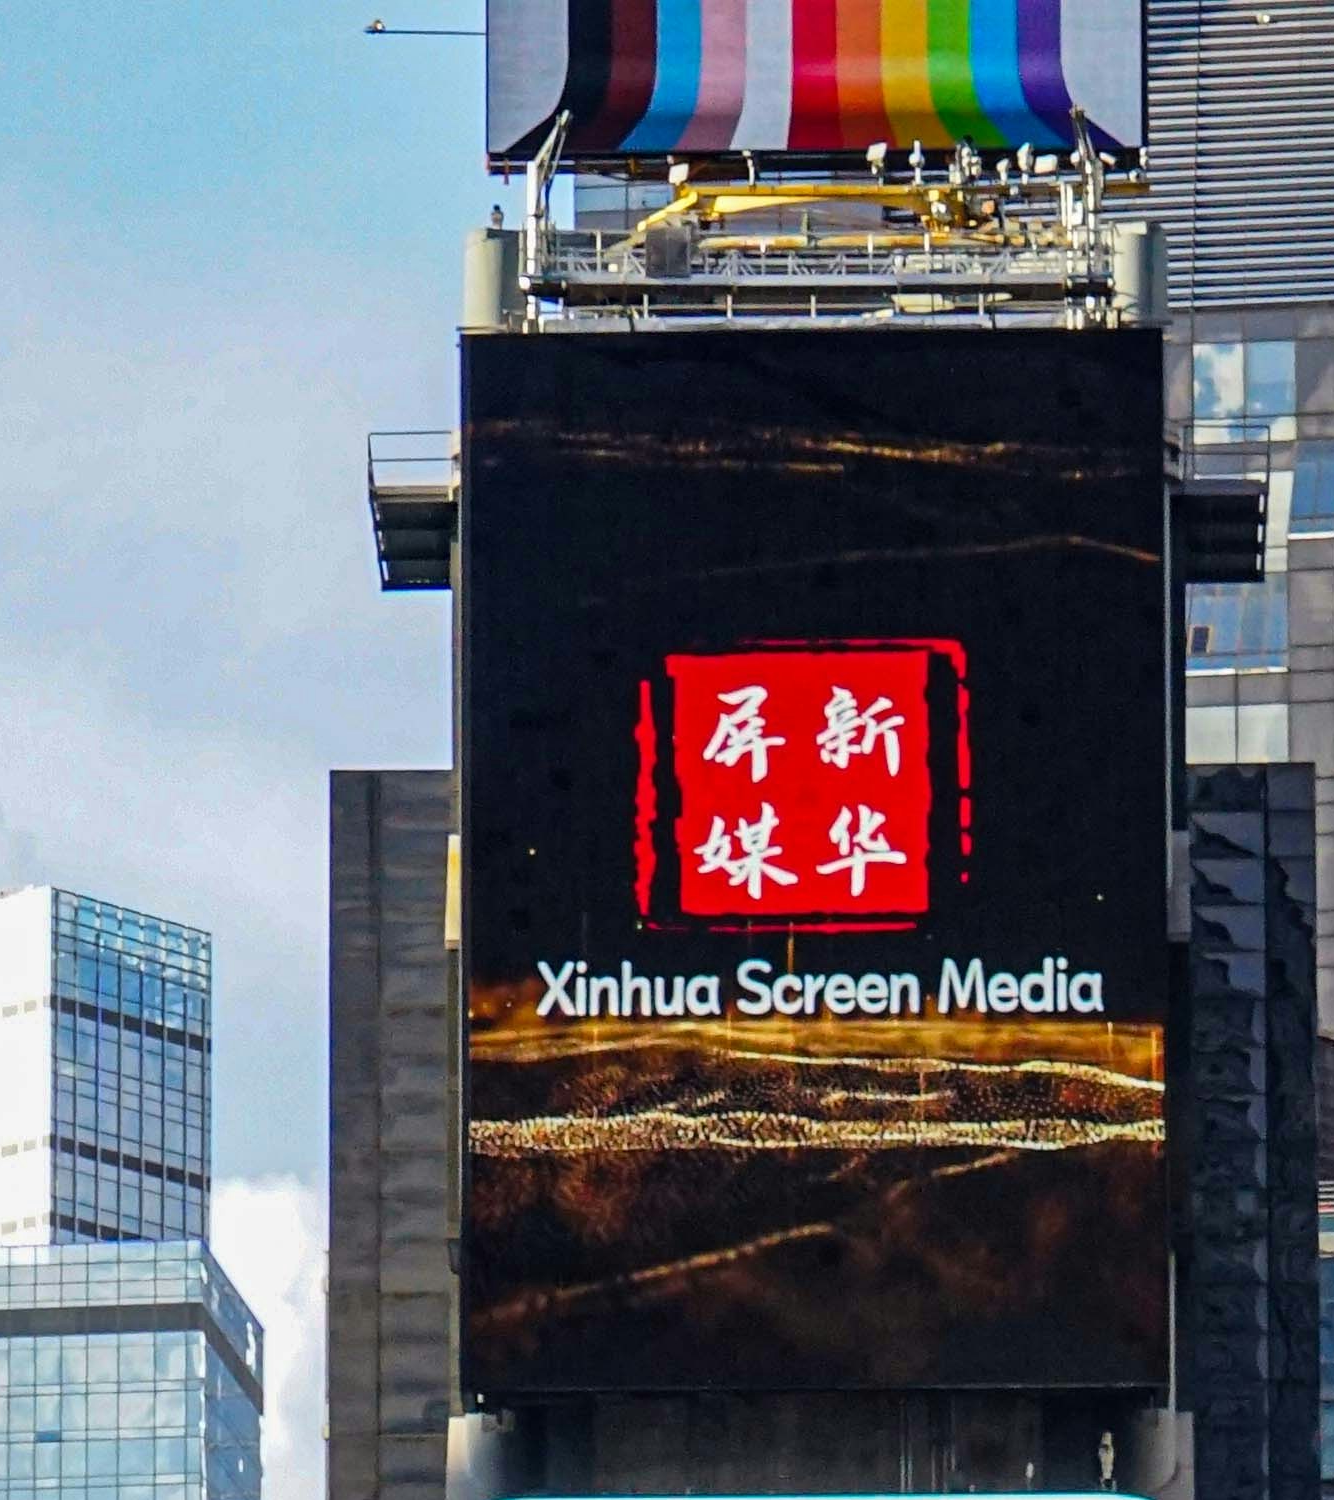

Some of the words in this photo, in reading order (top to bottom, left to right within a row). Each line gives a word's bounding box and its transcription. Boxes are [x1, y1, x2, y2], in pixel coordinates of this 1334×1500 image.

[538, 960, 720, 1017] Xinhua
[736, 959, 921, 1016] Screen
[937, 957, 1104, 1014] Media
